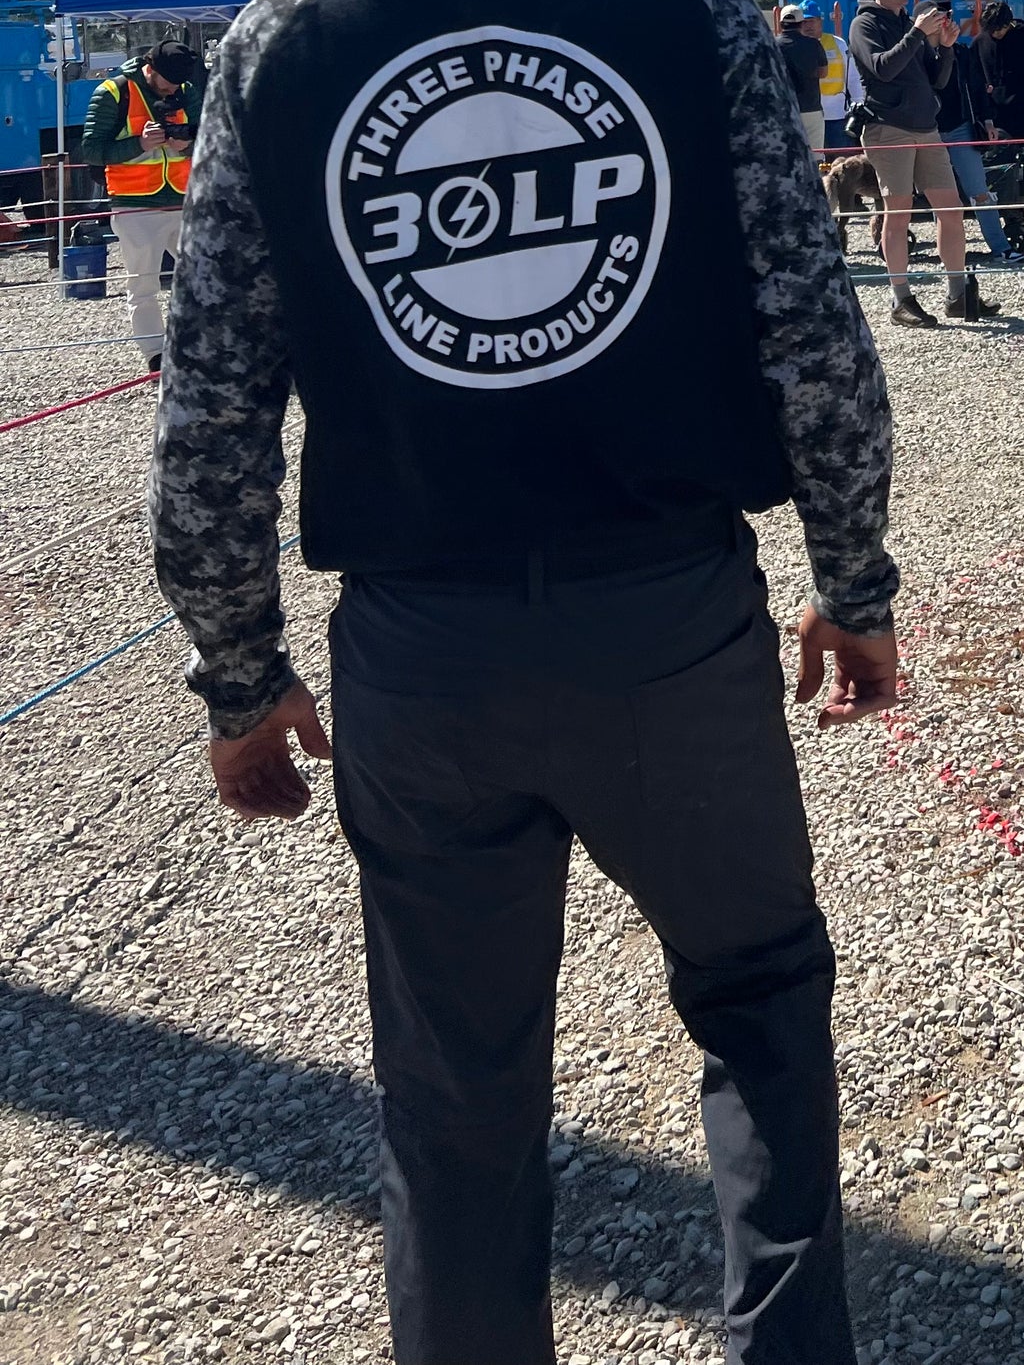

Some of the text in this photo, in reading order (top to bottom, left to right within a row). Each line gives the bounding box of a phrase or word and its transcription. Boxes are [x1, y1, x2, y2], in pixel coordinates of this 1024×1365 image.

[348, 50, 625, 182] THREE PHASE
[382, 234, 640, 364] LINE PRODUCTS
